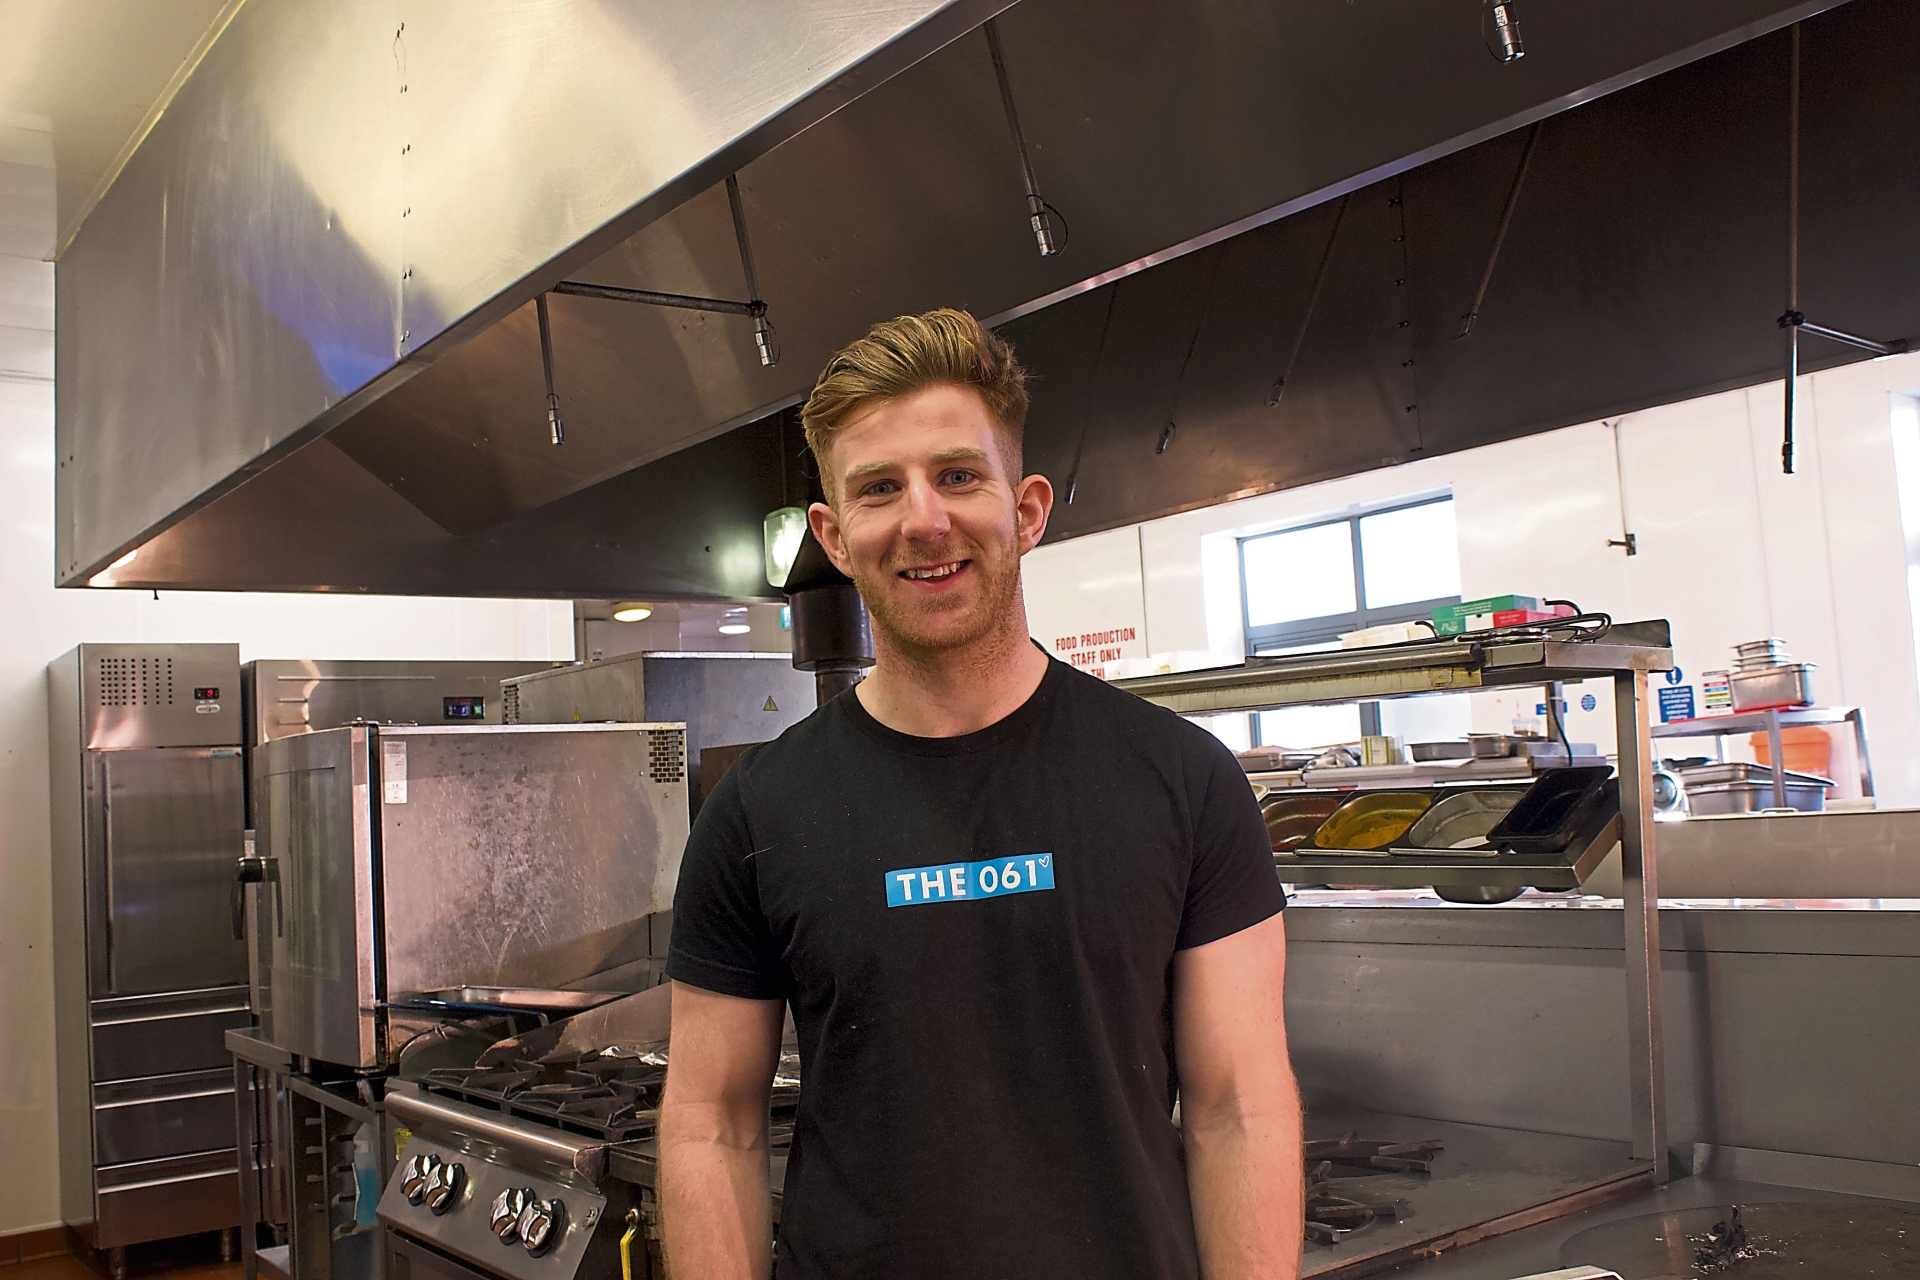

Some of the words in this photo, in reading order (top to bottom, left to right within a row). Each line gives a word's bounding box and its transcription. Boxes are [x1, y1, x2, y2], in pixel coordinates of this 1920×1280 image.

[1056, 637, 1077, 651] FOOD
[1081, 628, 1136, 648] PRODUCTION
[1071, 652, 1096, 666] STAFF
[1100, 648, 1122, 662] ONLY
[1091, 668, 1105, 680] THI
[897, 867, 966, 901] THE
[979, 860, 1037, 893] 061
